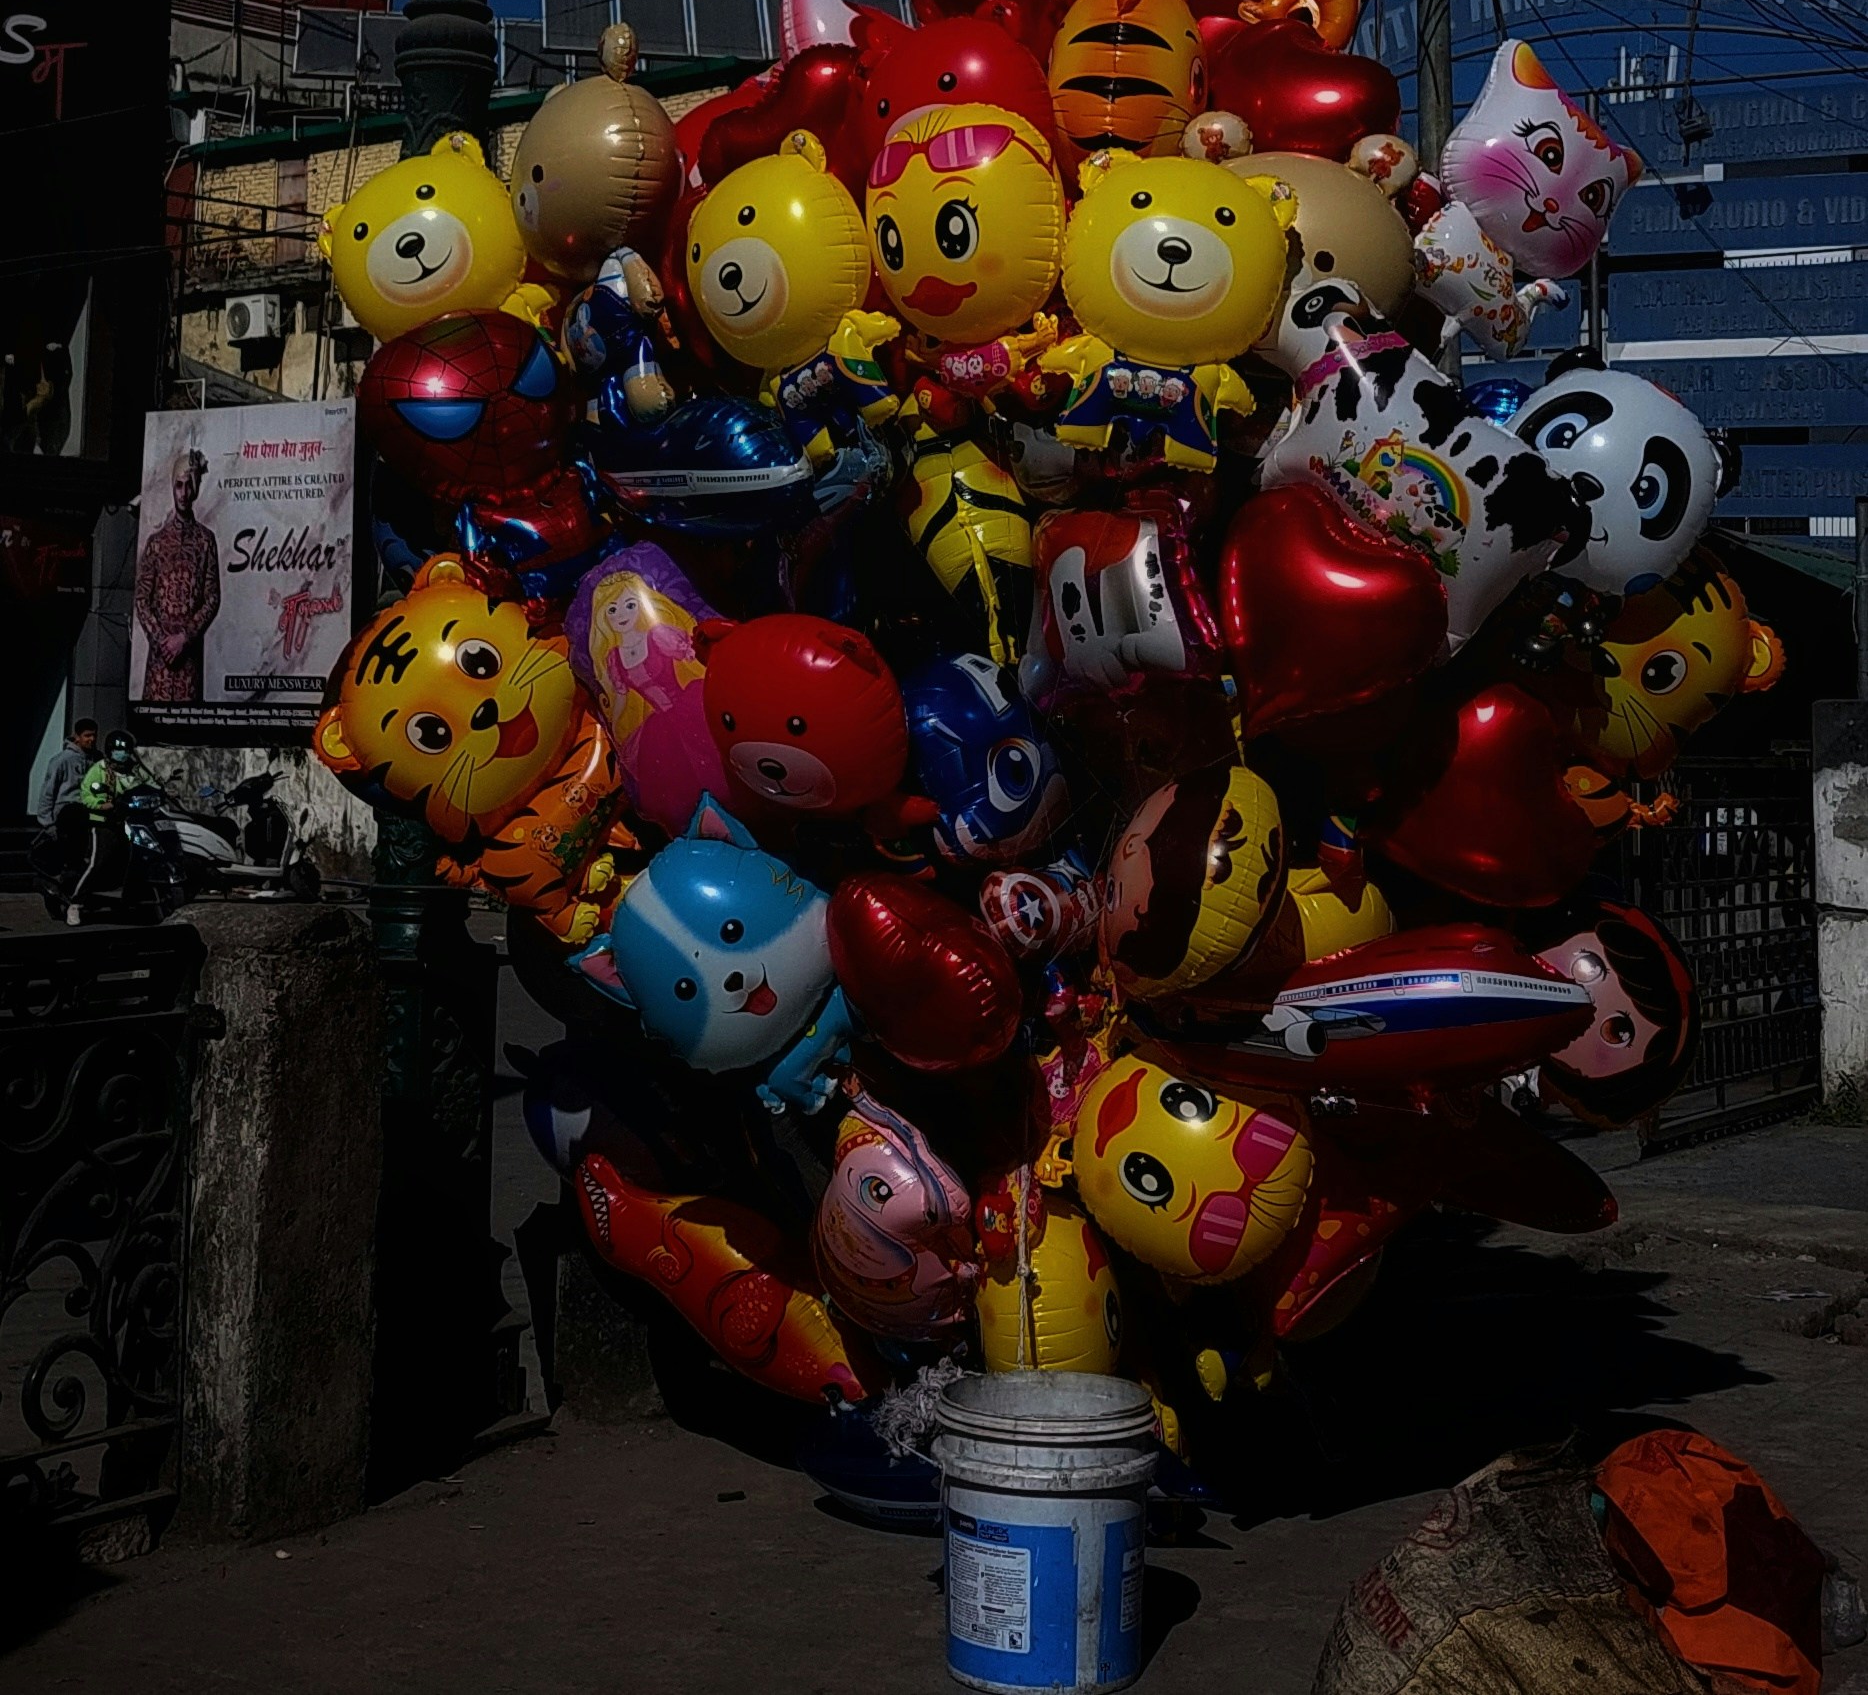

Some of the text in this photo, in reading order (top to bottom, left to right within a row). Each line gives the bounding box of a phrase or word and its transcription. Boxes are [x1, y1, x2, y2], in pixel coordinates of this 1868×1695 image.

[1709, 197, 1787, 231] AUDIO
[1797, 196, 1817, 226] &
[223, 477, 261, 489] PERFECT
[262, 476, 292, 488] ATTIRE
[295, 475, 302, 485] IS
[304, 473, 345, 485] CREATED
[233, 491, 251, 501] NOT
[227, 525, 336, 573] Shekhar
[228, 677, 323, 691] LUXURY MENSWEAR
